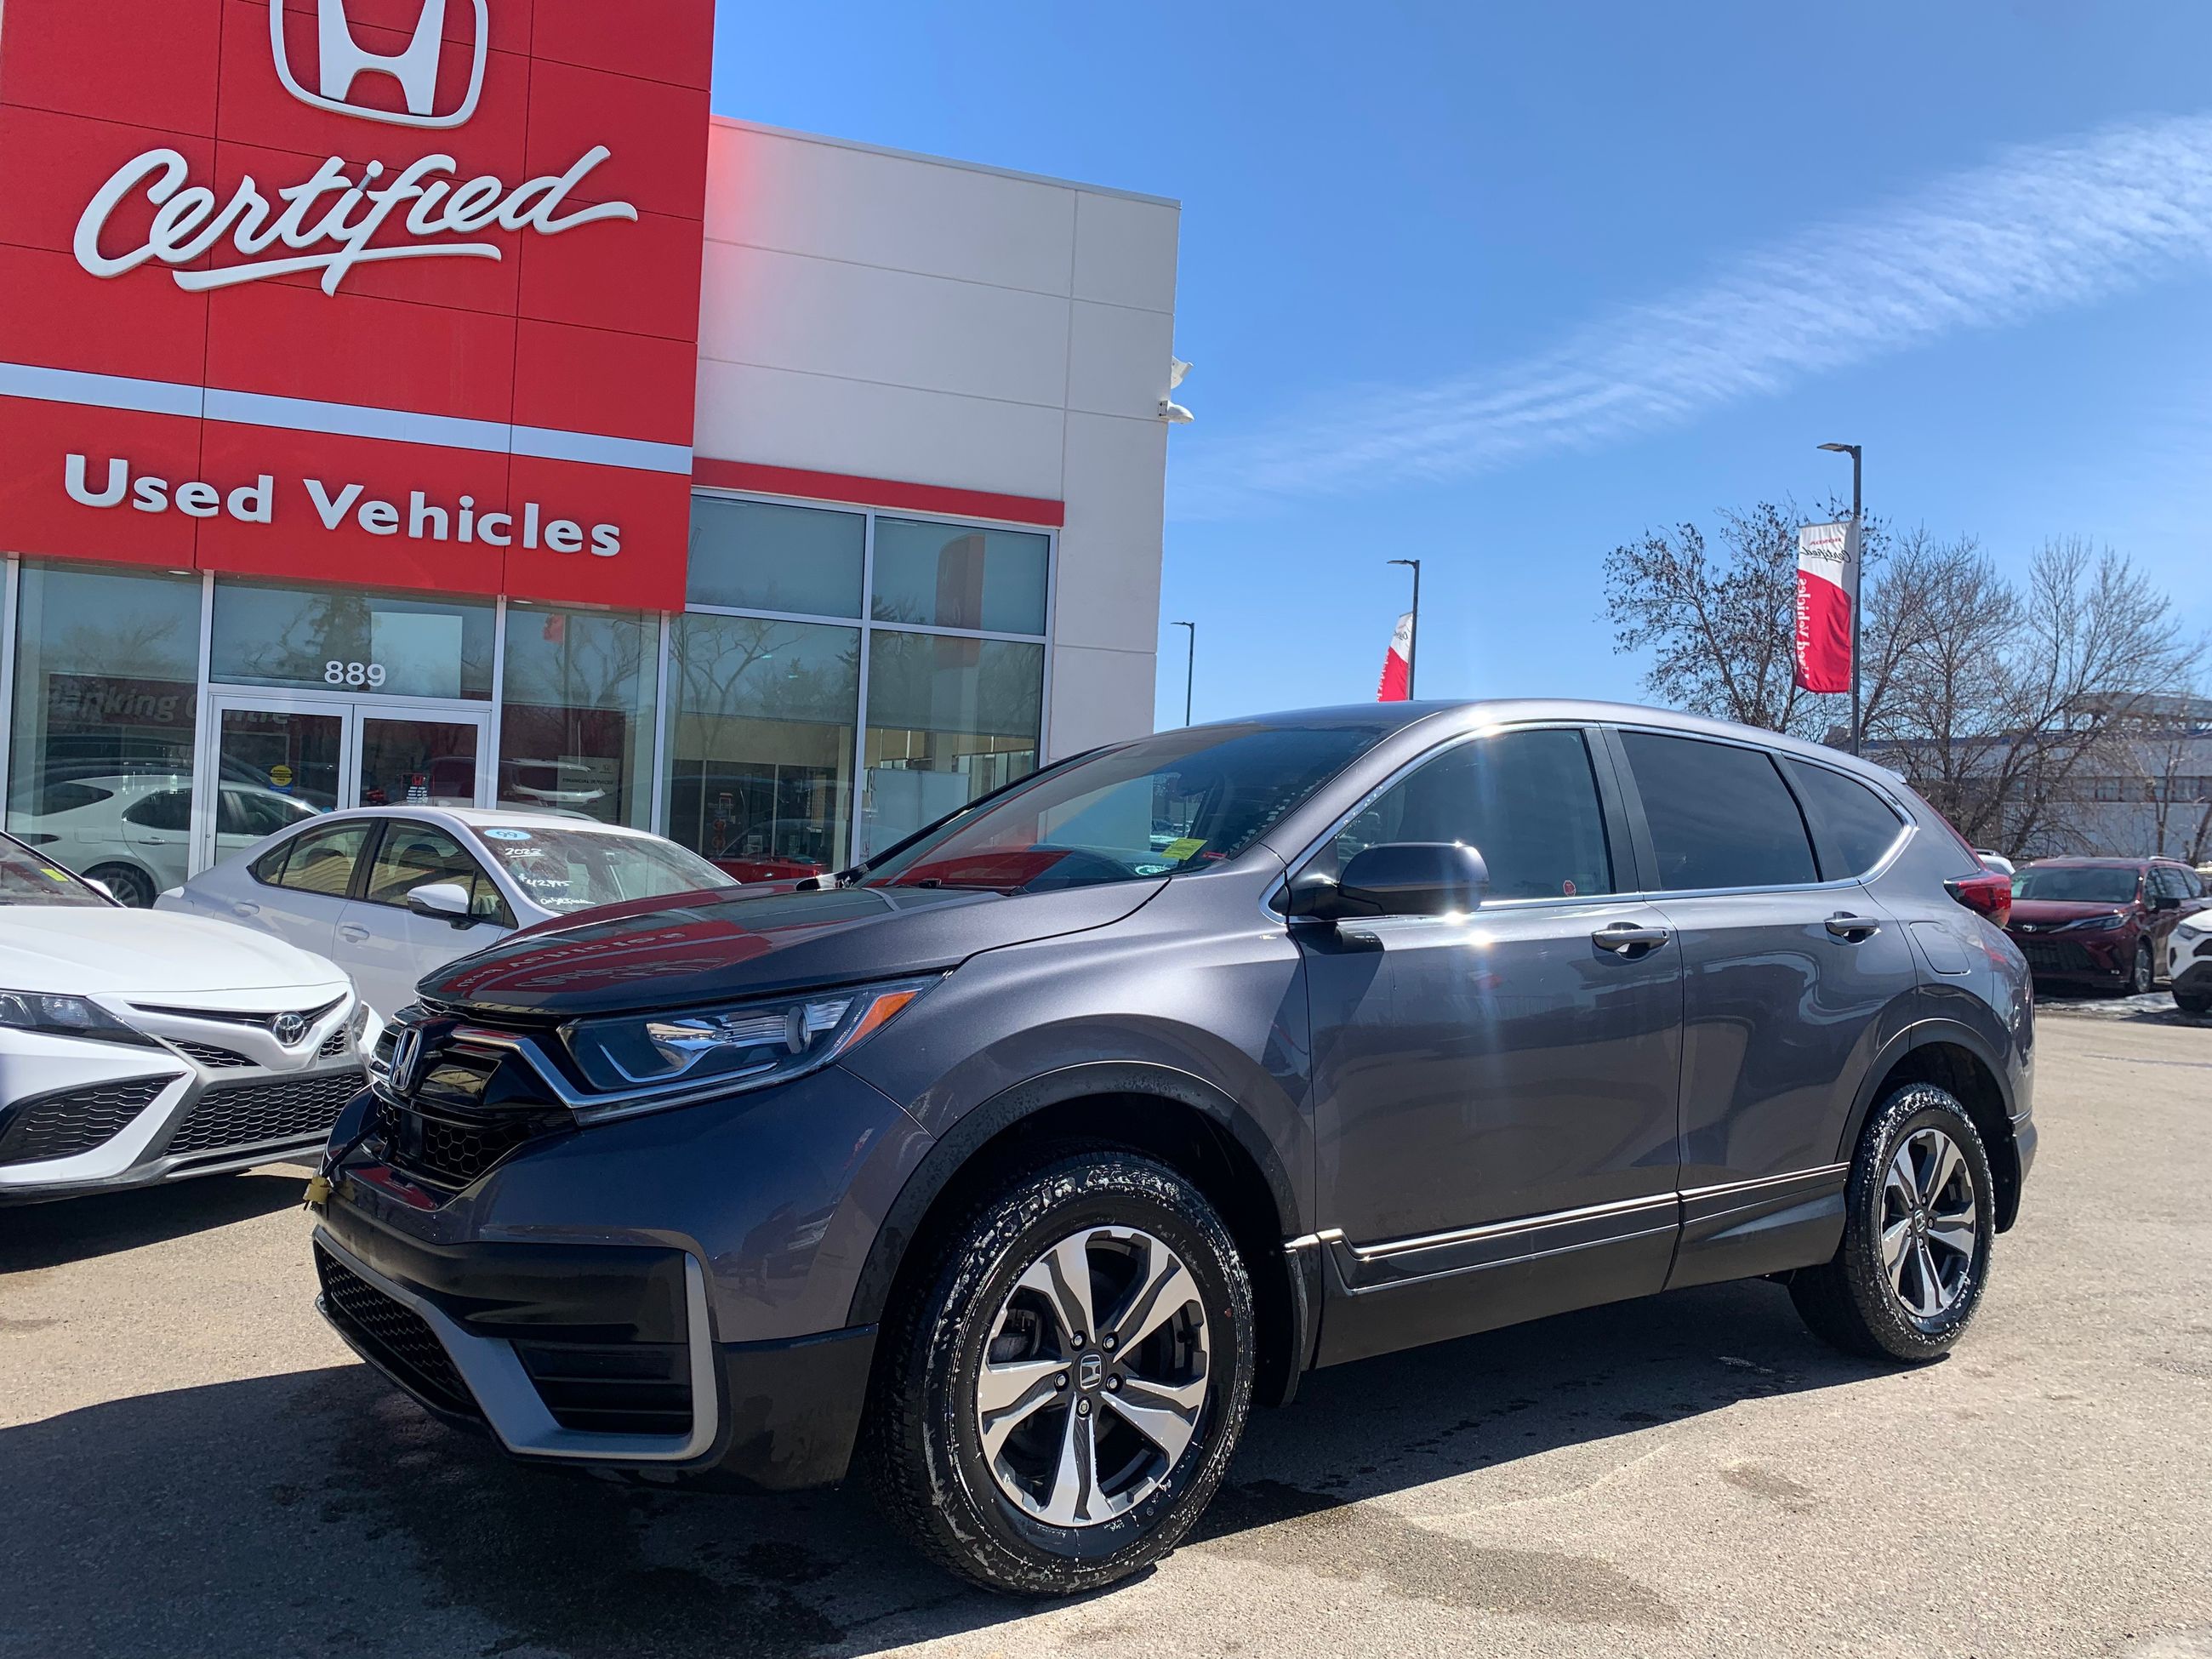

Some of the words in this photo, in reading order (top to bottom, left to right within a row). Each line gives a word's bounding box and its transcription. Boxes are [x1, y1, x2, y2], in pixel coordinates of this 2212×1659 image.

[73, 145, 639, 297] Certified
[64, 453, 275, 525] Used
[303, 477, 622, 558] Vehicles
[324, 660, 386, 687] 889
